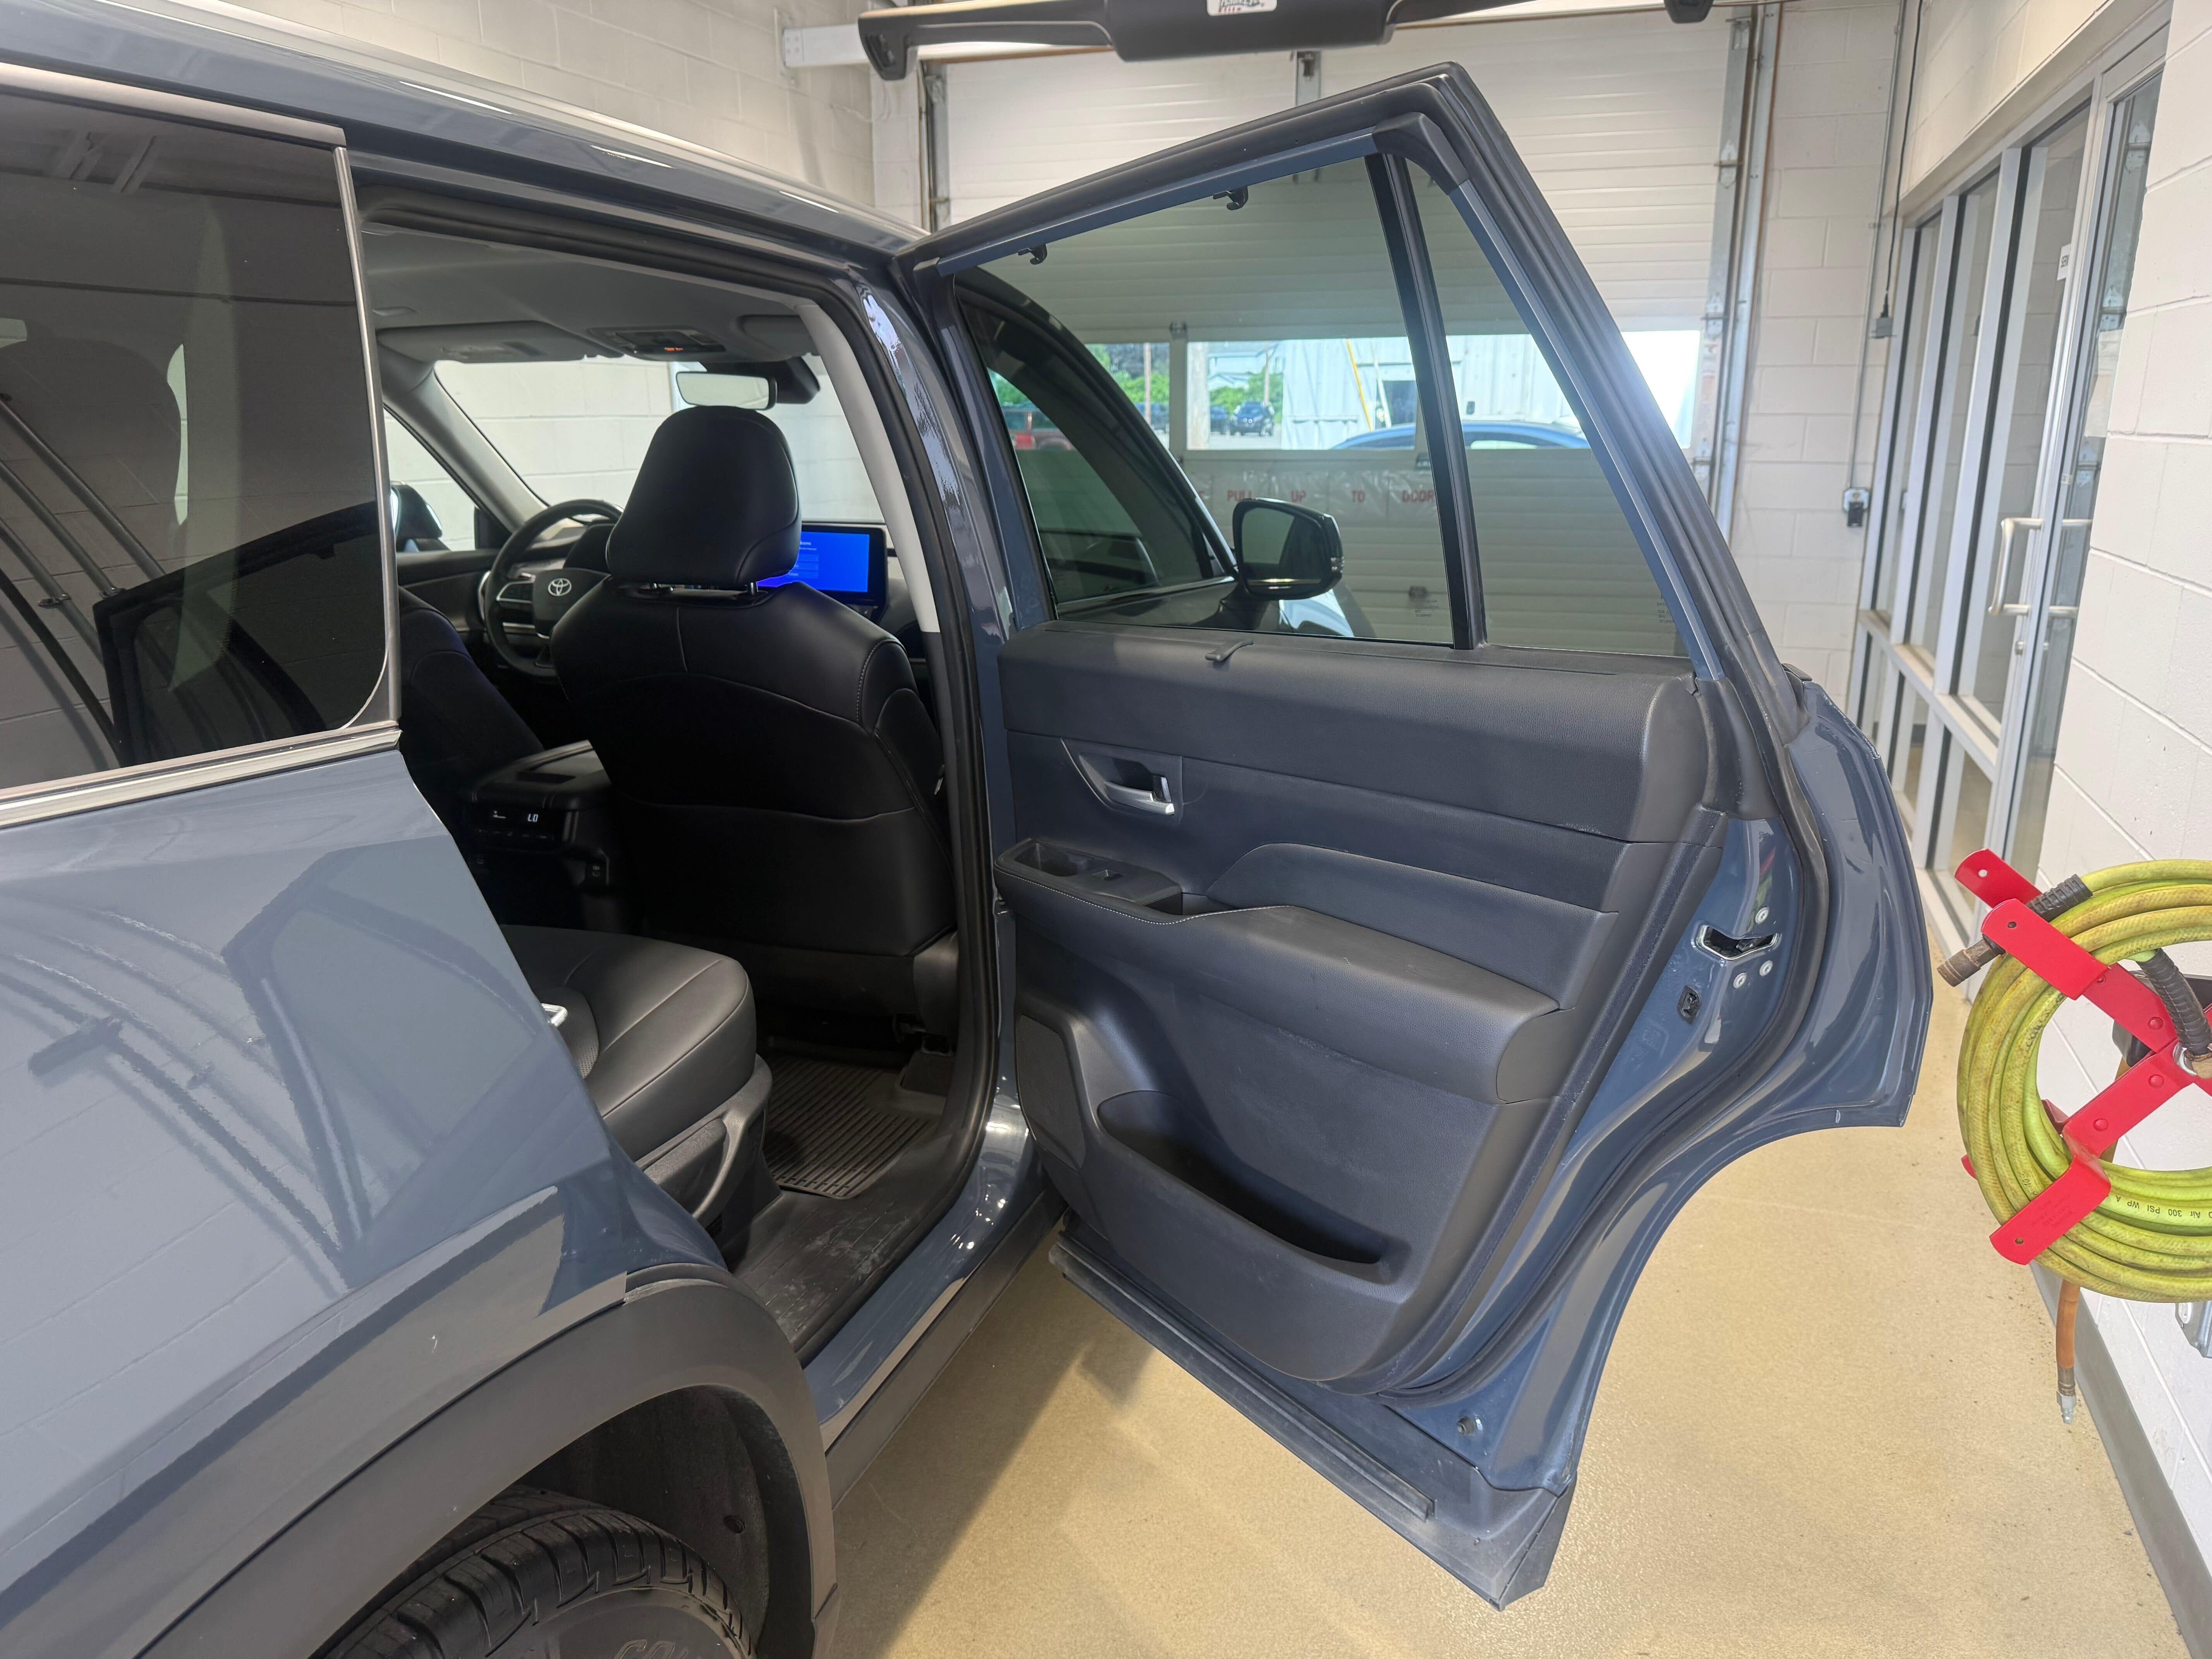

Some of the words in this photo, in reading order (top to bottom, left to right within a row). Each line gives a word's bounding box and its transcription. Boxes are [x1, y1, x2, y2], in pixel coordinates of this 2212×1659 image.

[1291, 490, 1307, 502] UP
[1352, 490, 1365, 502] TO
[1402, 490, 1435, 502] DOOR
[2127, 1200, 2140, 1209] WP
[2147, 1205, 2160, 1214] PSI
[2169, 1209, 2182, 1217] 300
